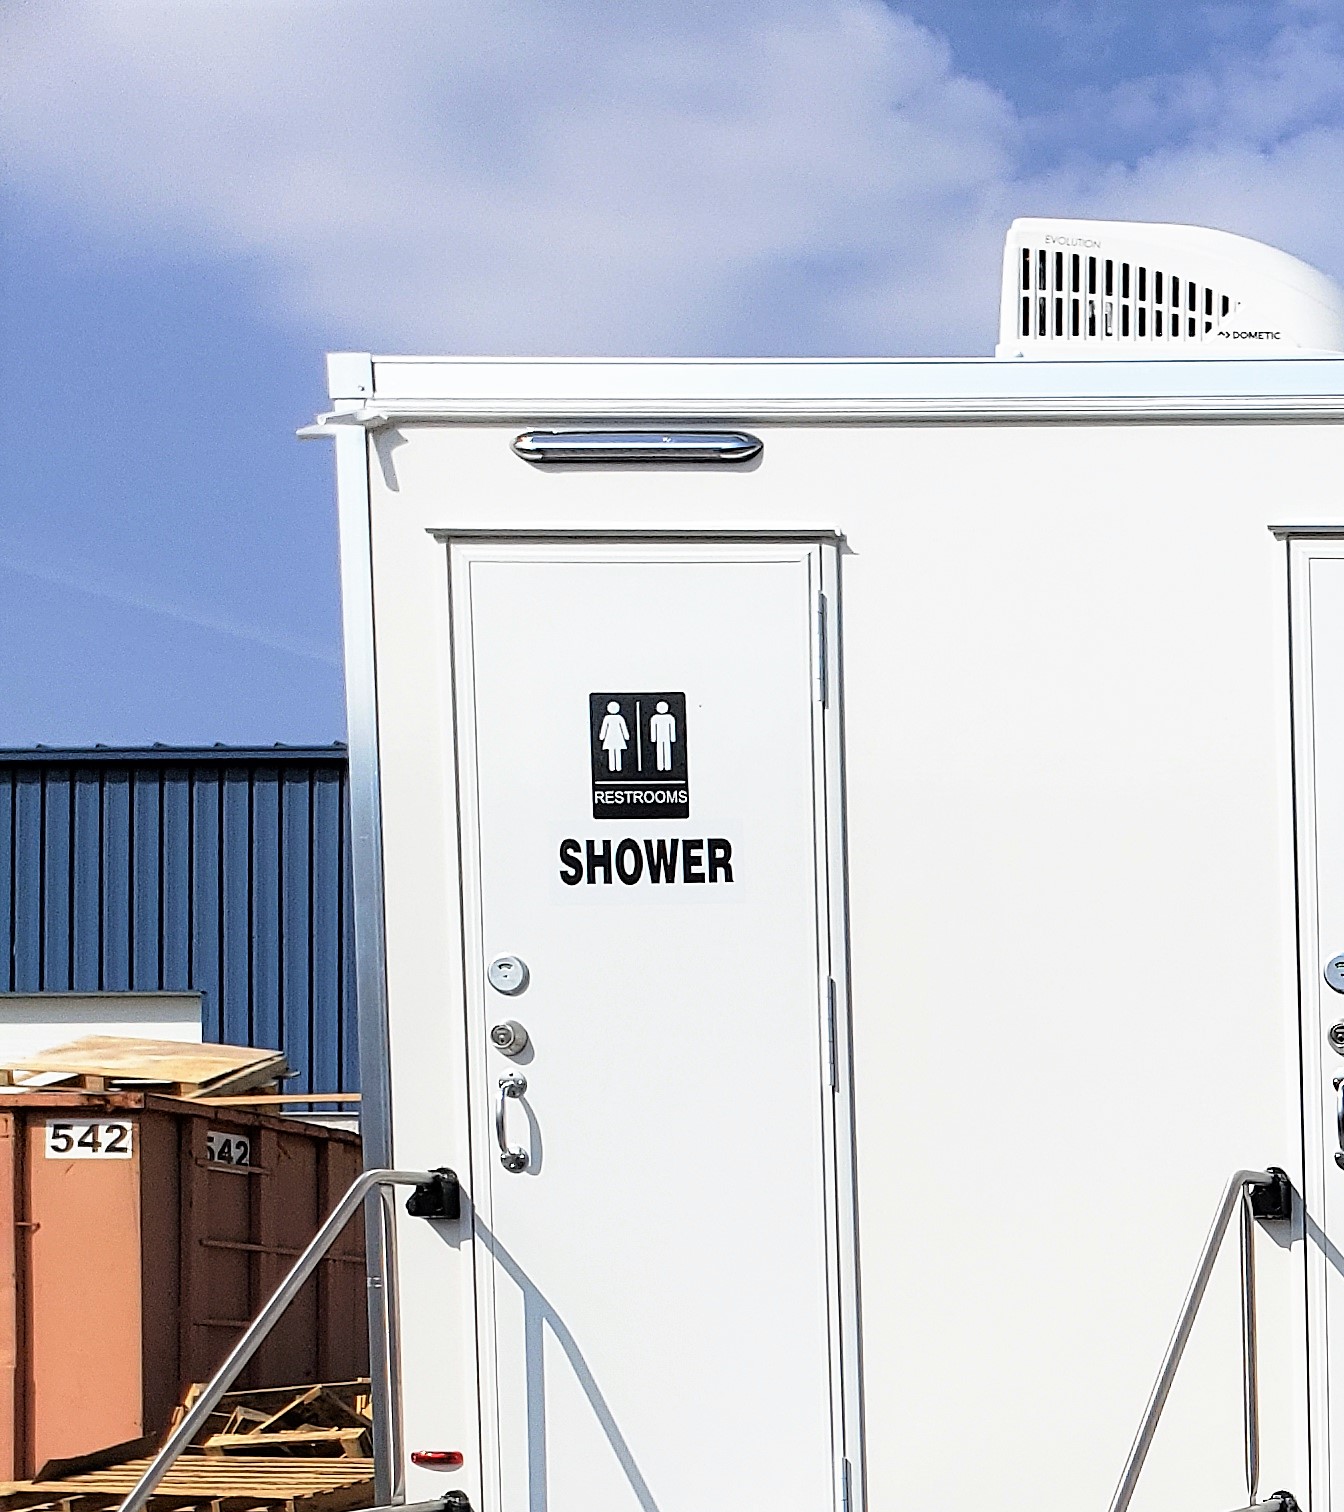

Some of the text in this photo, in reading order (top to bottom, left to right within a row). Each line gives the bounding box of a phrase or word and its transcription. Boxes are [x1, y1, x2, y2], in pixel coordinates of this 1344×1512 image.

[1045, 234, 1101, 249] EVOLUTION
[1233, 331, 1281, 340] DOMETIC
[595, 790, 688, 804] RESTROOMS
[560, 837, 735, 886] SHOWER
[50, 1123, 128, 1154] 542
